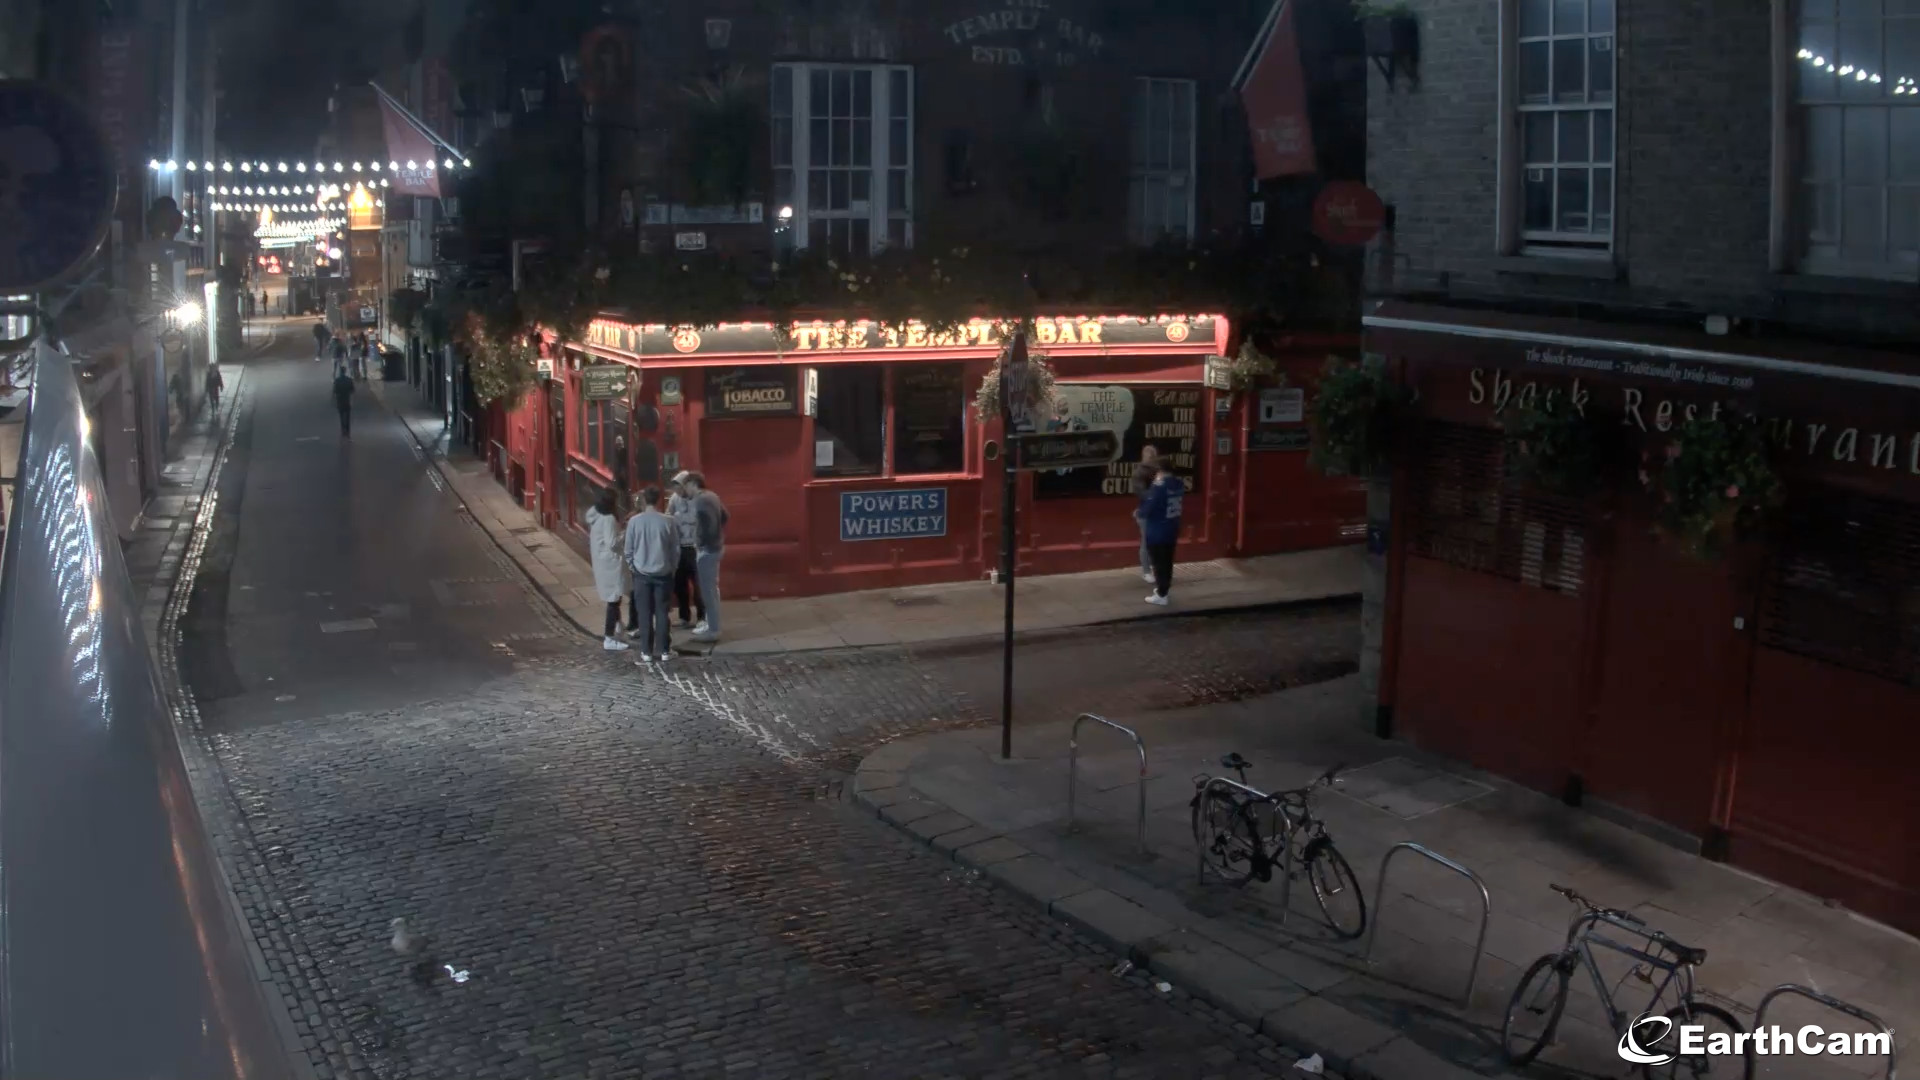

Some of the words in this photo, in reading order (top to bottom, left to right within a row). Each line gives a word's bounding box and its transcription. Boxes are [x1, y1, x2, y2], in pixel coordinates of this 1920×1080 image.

[790, 326, 868, 350] THE
[1036, 322, 1102, 344] BAR
[1526, 349, 1541, 361] The
[1567, 354, 1614, 370] Restaurant
[724, 386, 785, 408] TOBACCO
[1091, 391, 1116, 402] THE
[1080, 402, 1126, 413] TEMPLE
[1172, 407, 1196, 422] THE
[1091, 412, 1115, 424] BAR
[1145, 423, 1196, 438] EMPEROR
[850, 493, 939, 513] POWER'S
[845, 516, 943, 535] WHISKEY
